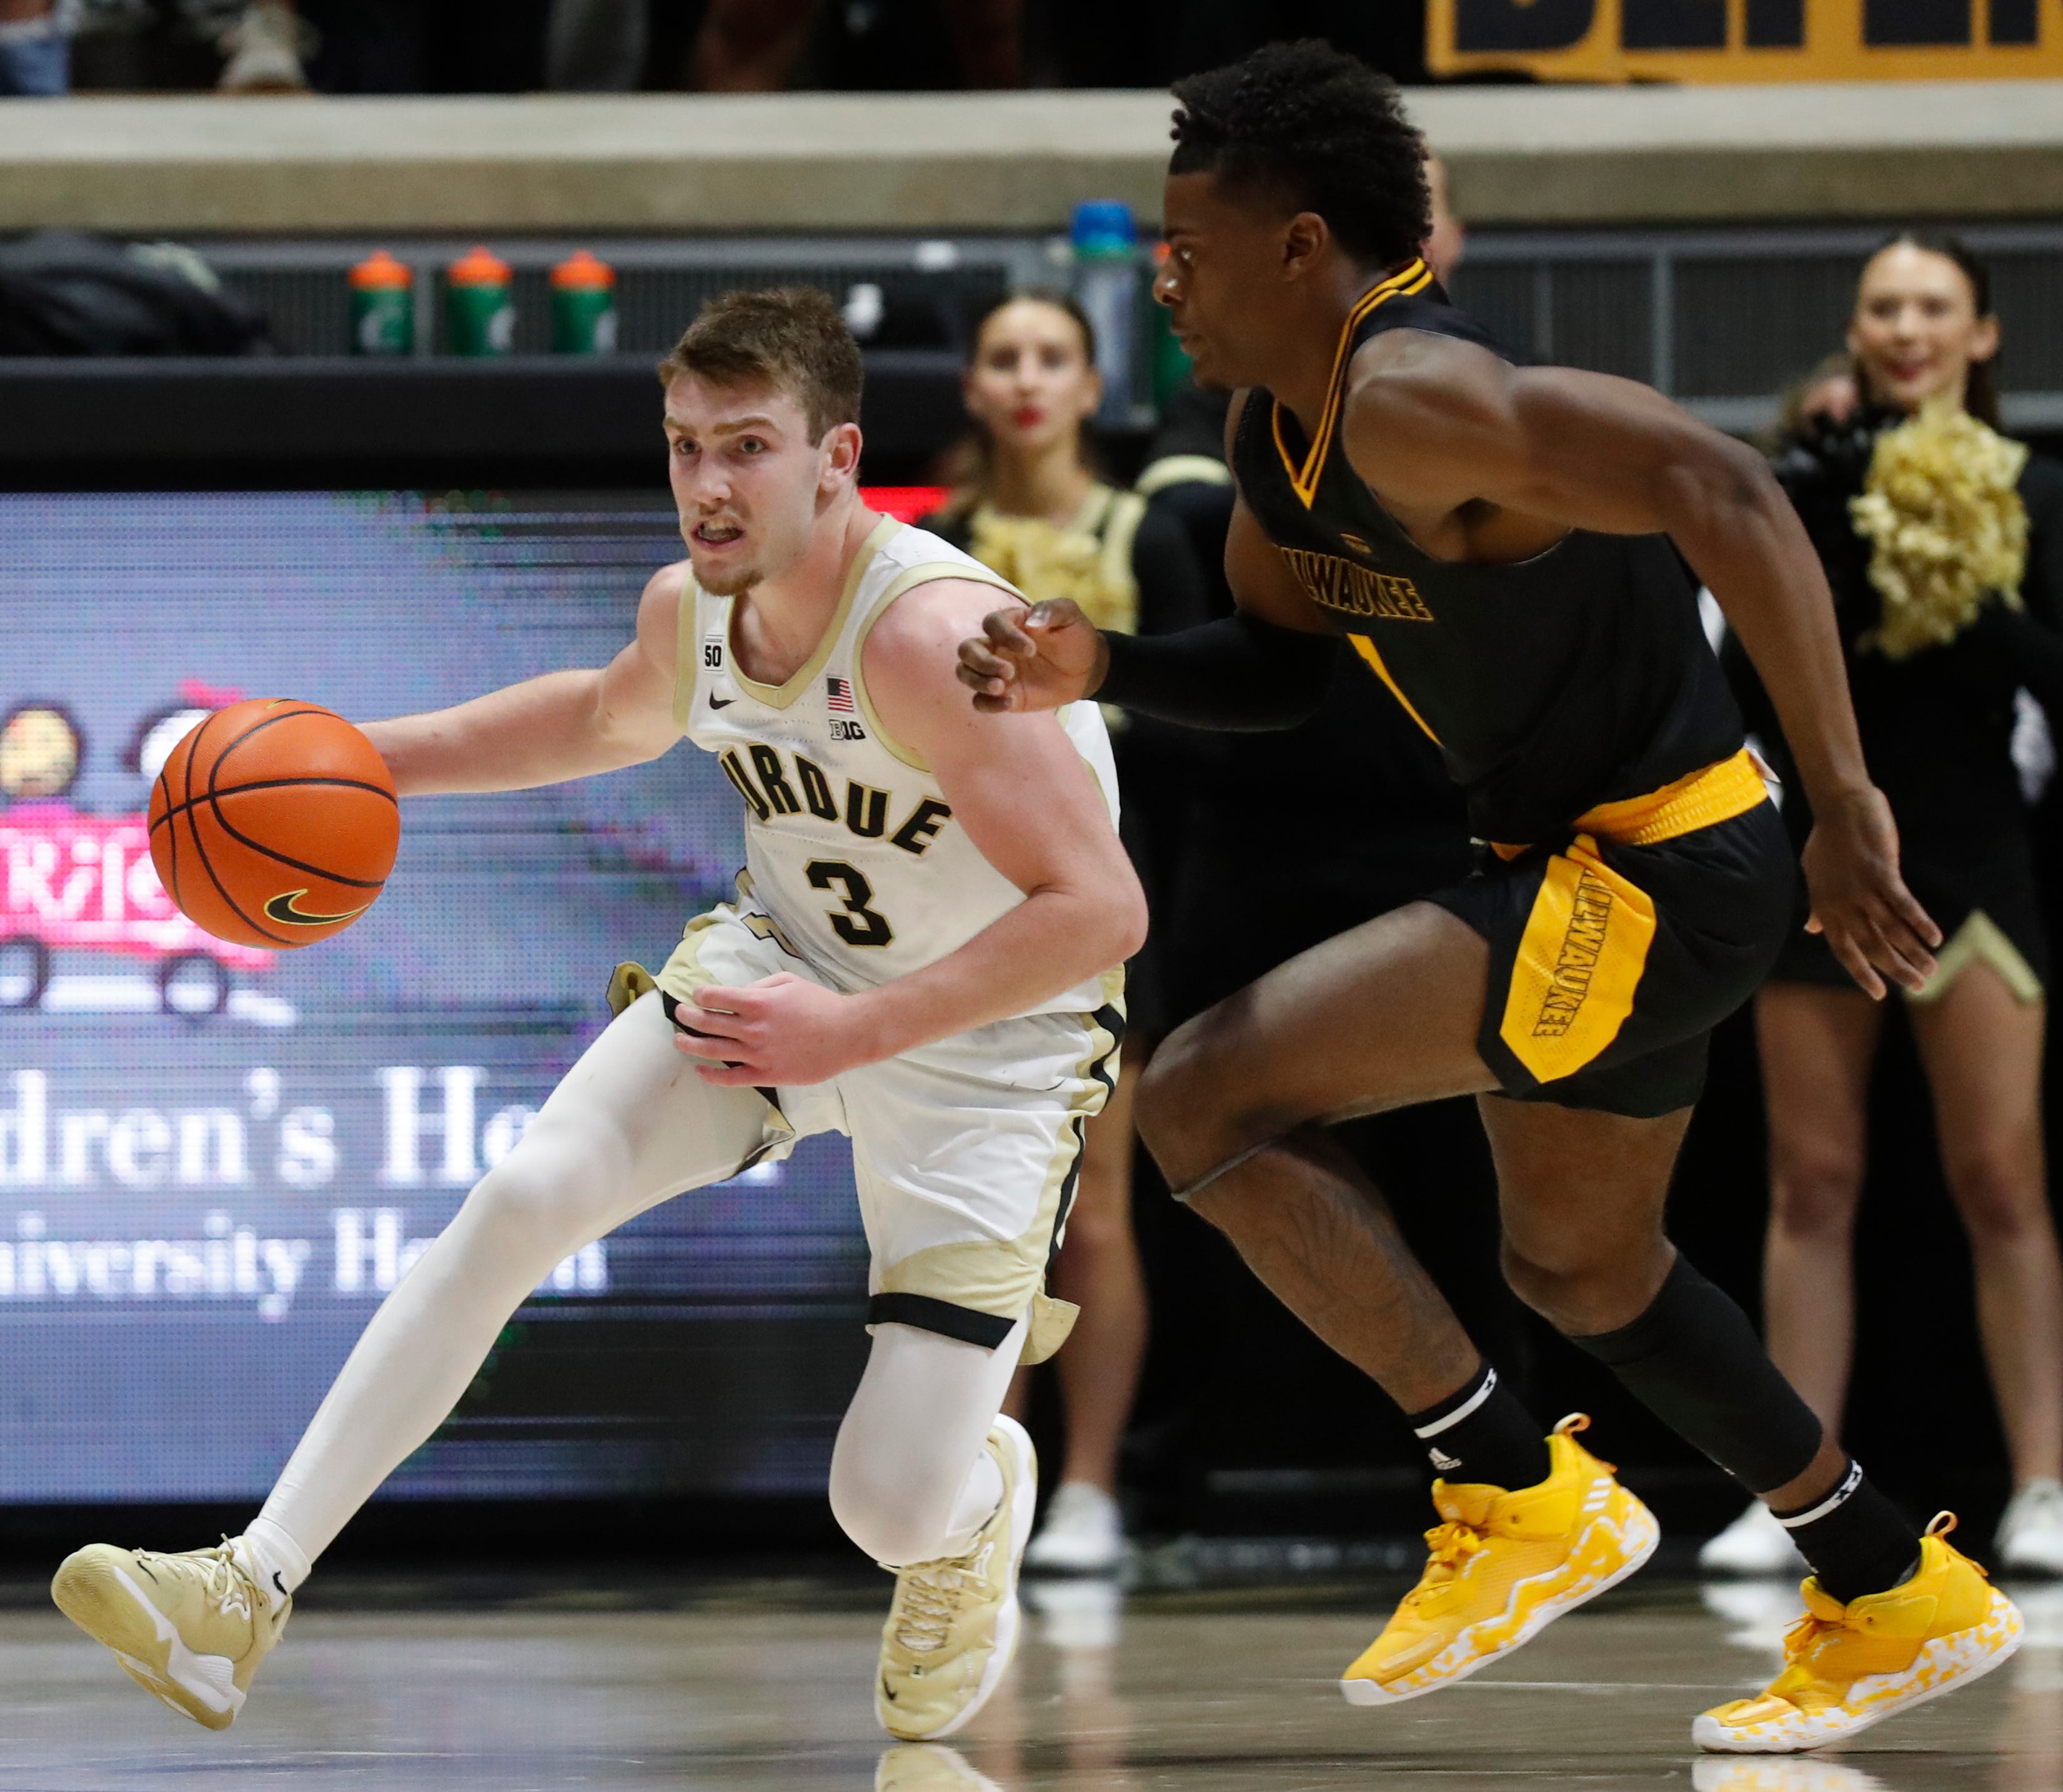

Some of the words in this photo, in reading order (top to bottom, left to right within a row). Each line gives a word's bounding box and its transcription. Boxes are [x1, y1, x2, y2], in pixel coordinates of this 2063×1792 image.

[705, 645, 722, 667] 50
[718, 741, 953, 856] URDUE
[803, 858, 897, 948] 3
[1531, 868, 1614, 1037] ILWAUKEE
